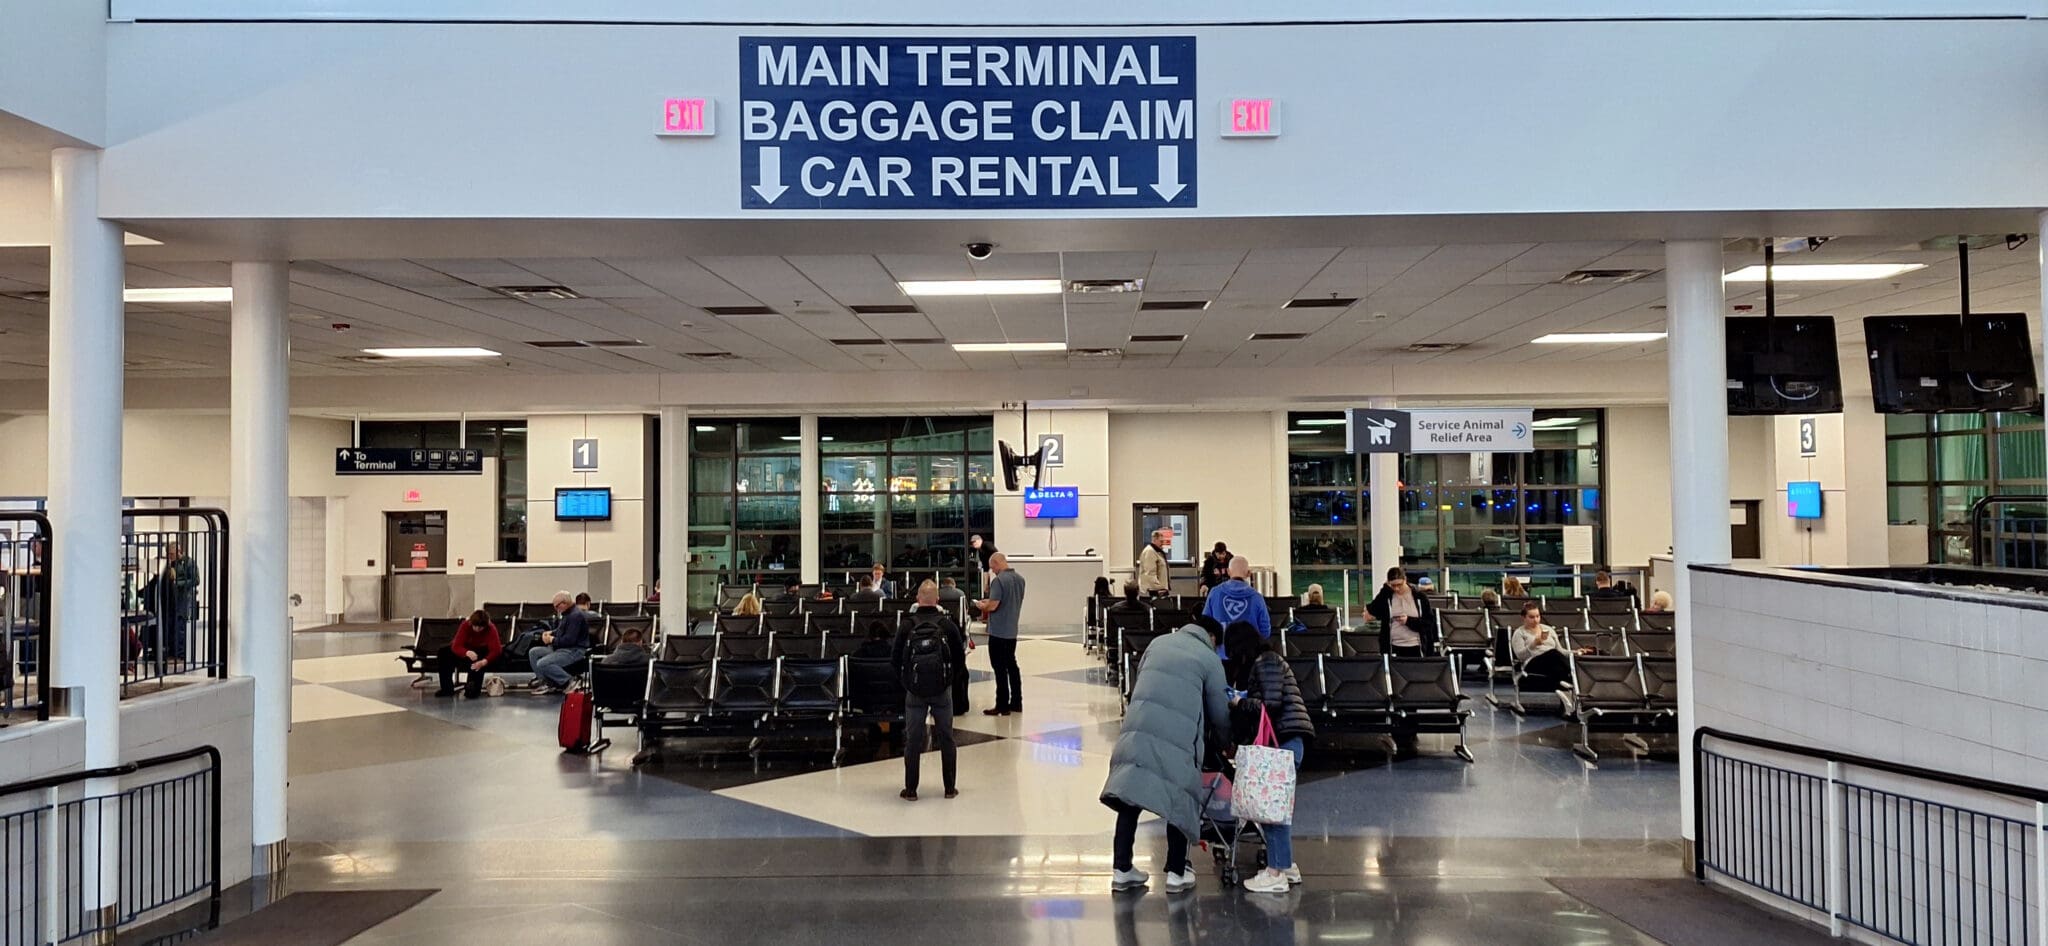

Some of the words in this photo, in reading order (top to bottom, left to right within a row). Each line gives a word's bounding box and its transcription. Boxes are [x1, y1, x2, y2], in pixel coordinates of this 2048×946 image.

[757, 46, 889, 86] MAIN
[907, 46, 1179, 86] TERMINAL
[665, 99, 705, 131] EXIT
[744, 100, 1014, 142] BAGGAGE
[1031, 100, 1194, 141] CLAIM
[1231, 100, 1272, 132] EXIT
[800, 156, 915, 197] CAR
[932, 156, 1138, 197] RENTAL
[1418, 420, 1461, 431] Service
[1463, 419, 1504, 430] Animal
[1430, 432, 1463, 442] Relief
[1466, 433, 1492, 442] Area
[1802, 422, 1813, 450] 3
[354, 451, 367, 461] To
[577, 442, 590, 466] 1
[1043, 438, 1059, 461] 2
[354, 460, 396, 470] Terminal
